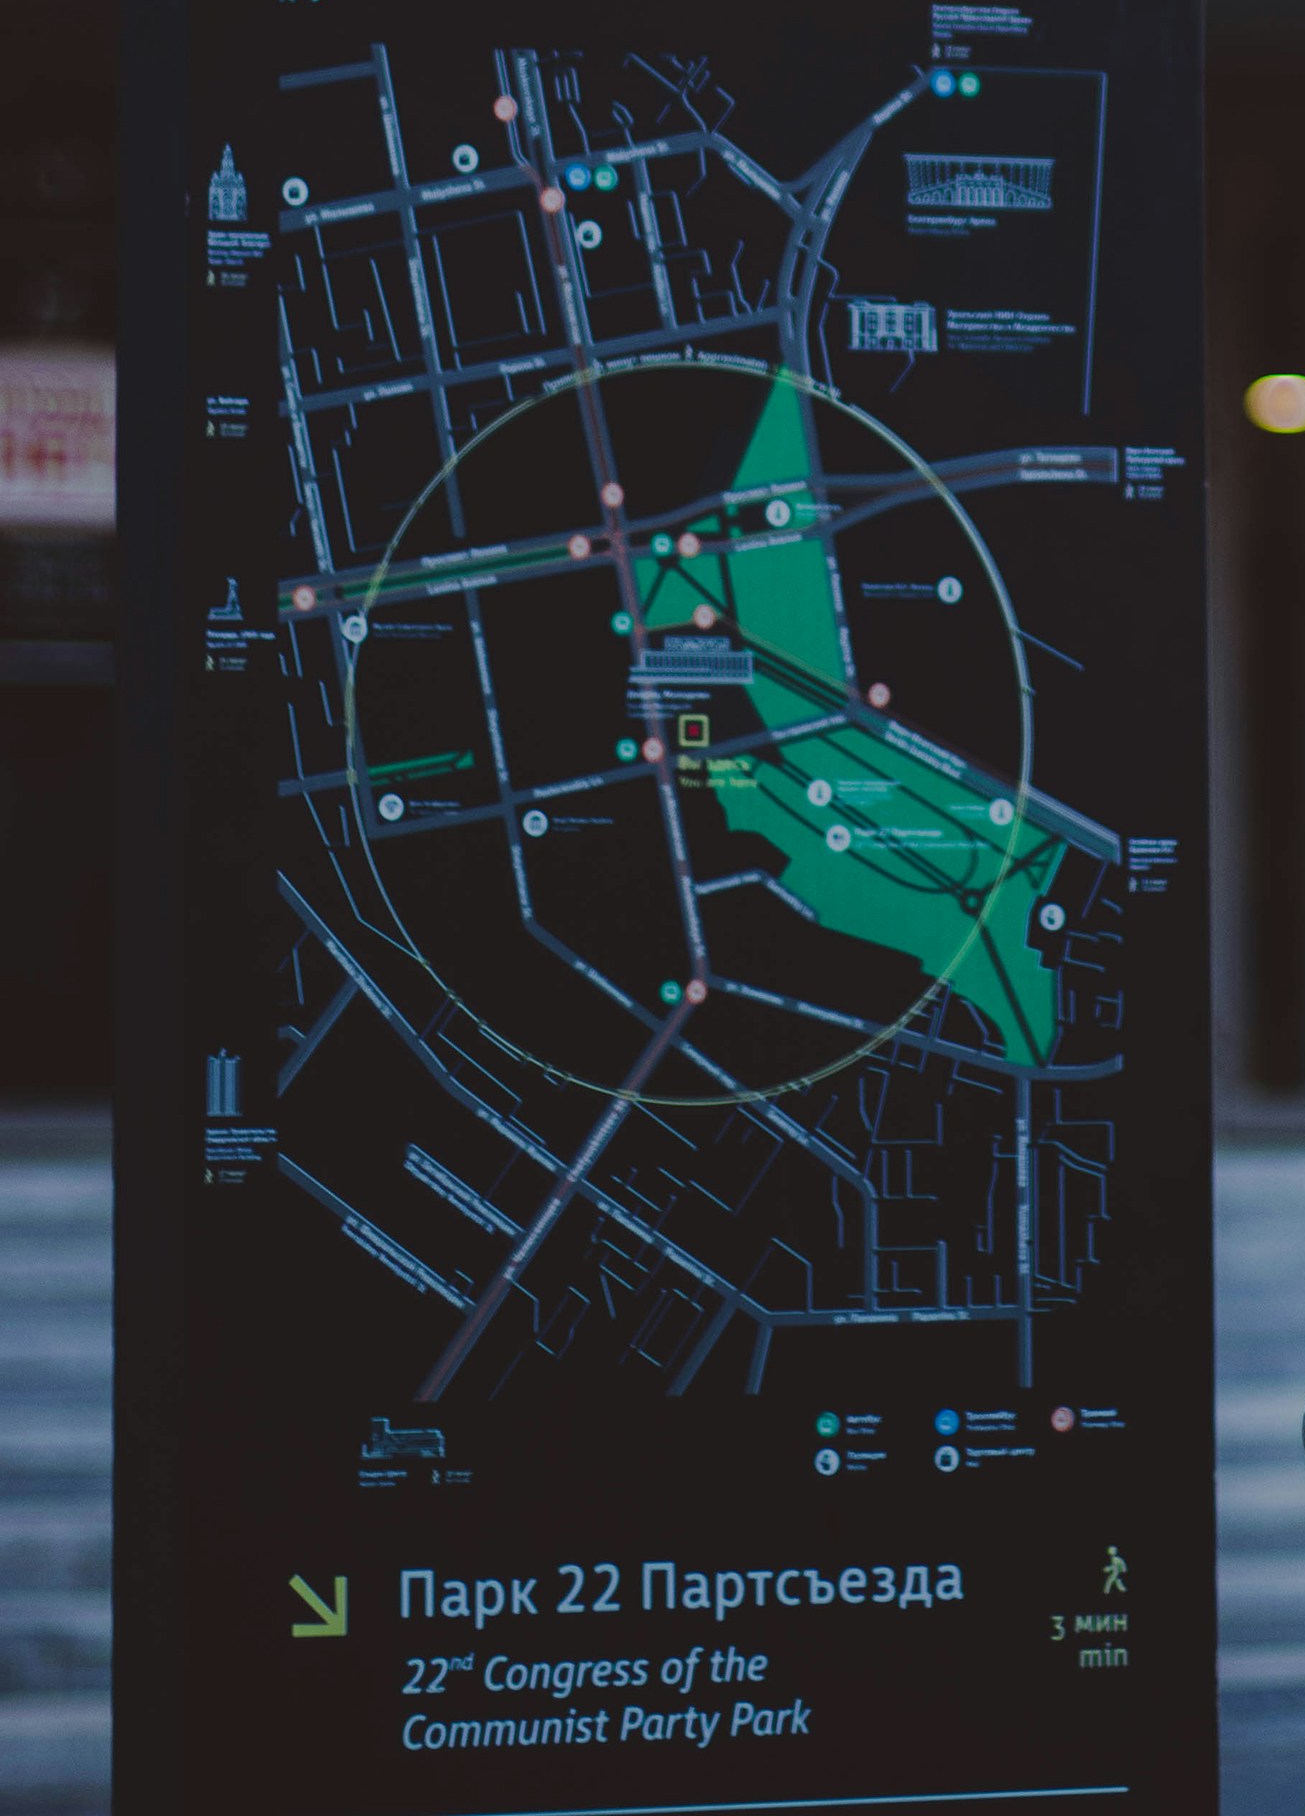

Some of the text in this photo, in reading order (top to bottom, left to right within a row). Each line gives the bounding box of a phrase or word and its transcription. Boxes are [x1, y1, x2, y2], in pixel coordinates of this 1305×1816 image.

[400, 1561, 964, 1630] Парк 22 Партсъезда
[1050, 1614, 1128, 1641] 3 мин
[484, 1655, 649, 1699] Congress
[660, 1646, 705, 1694] of
[710, 1646, 768, 1683] the
[1079, 1642, 1128, 1668] min
[402, 1698, 812, 1751] Communist Party Park
